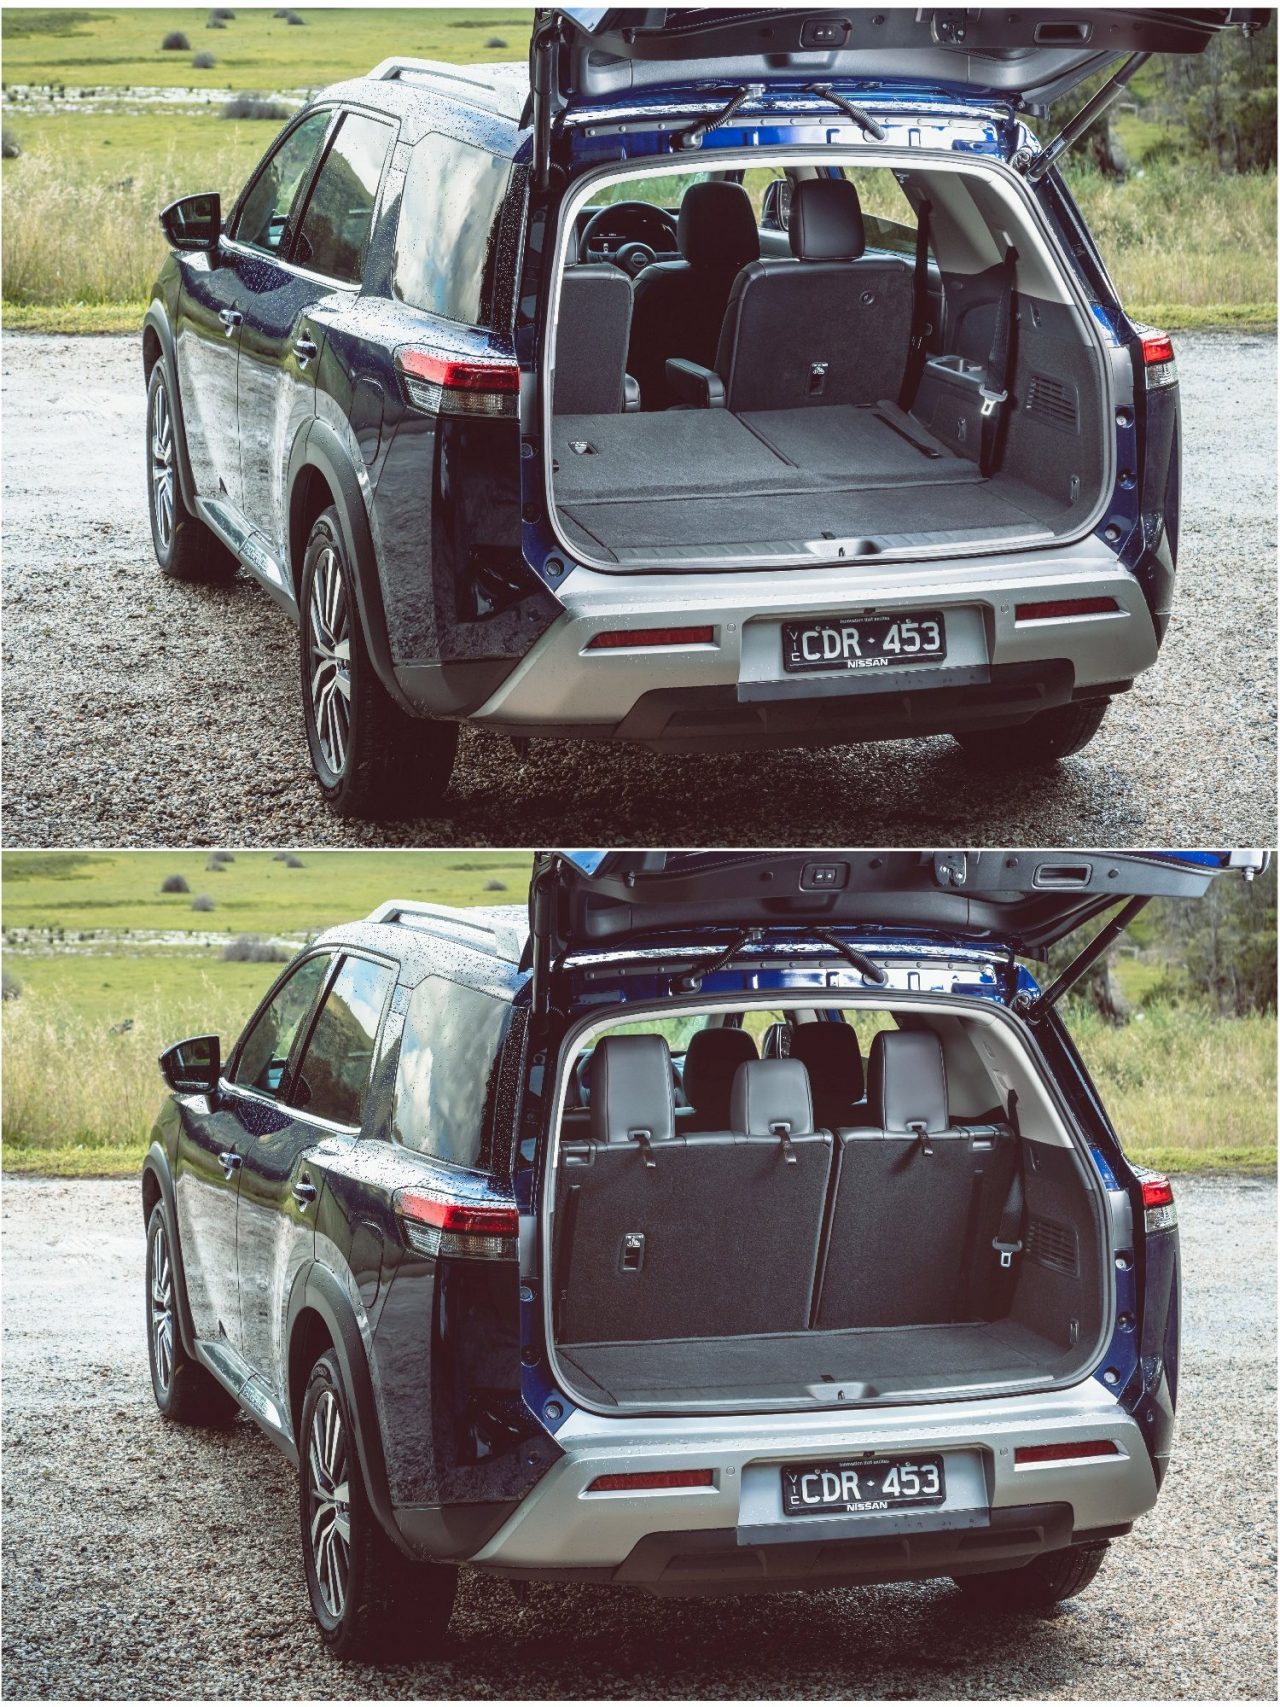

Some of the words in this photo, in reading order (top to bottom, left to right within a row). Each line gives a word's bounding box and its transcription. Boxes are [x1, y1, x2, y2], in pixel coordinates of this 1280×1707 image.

[789, 632, 801, 662] VIC
[802, 628, 862, 661] CDR
[882, 621, 940, 654] 453
[847, 658, 889, 669] NISSAN
[788, 1473, 800, 1505] VIC
[801, 1471, 862, 1504] CDR
[882, 1464, 940, 1497] 453
[846, 1501, 888, 1512] NISSAN
